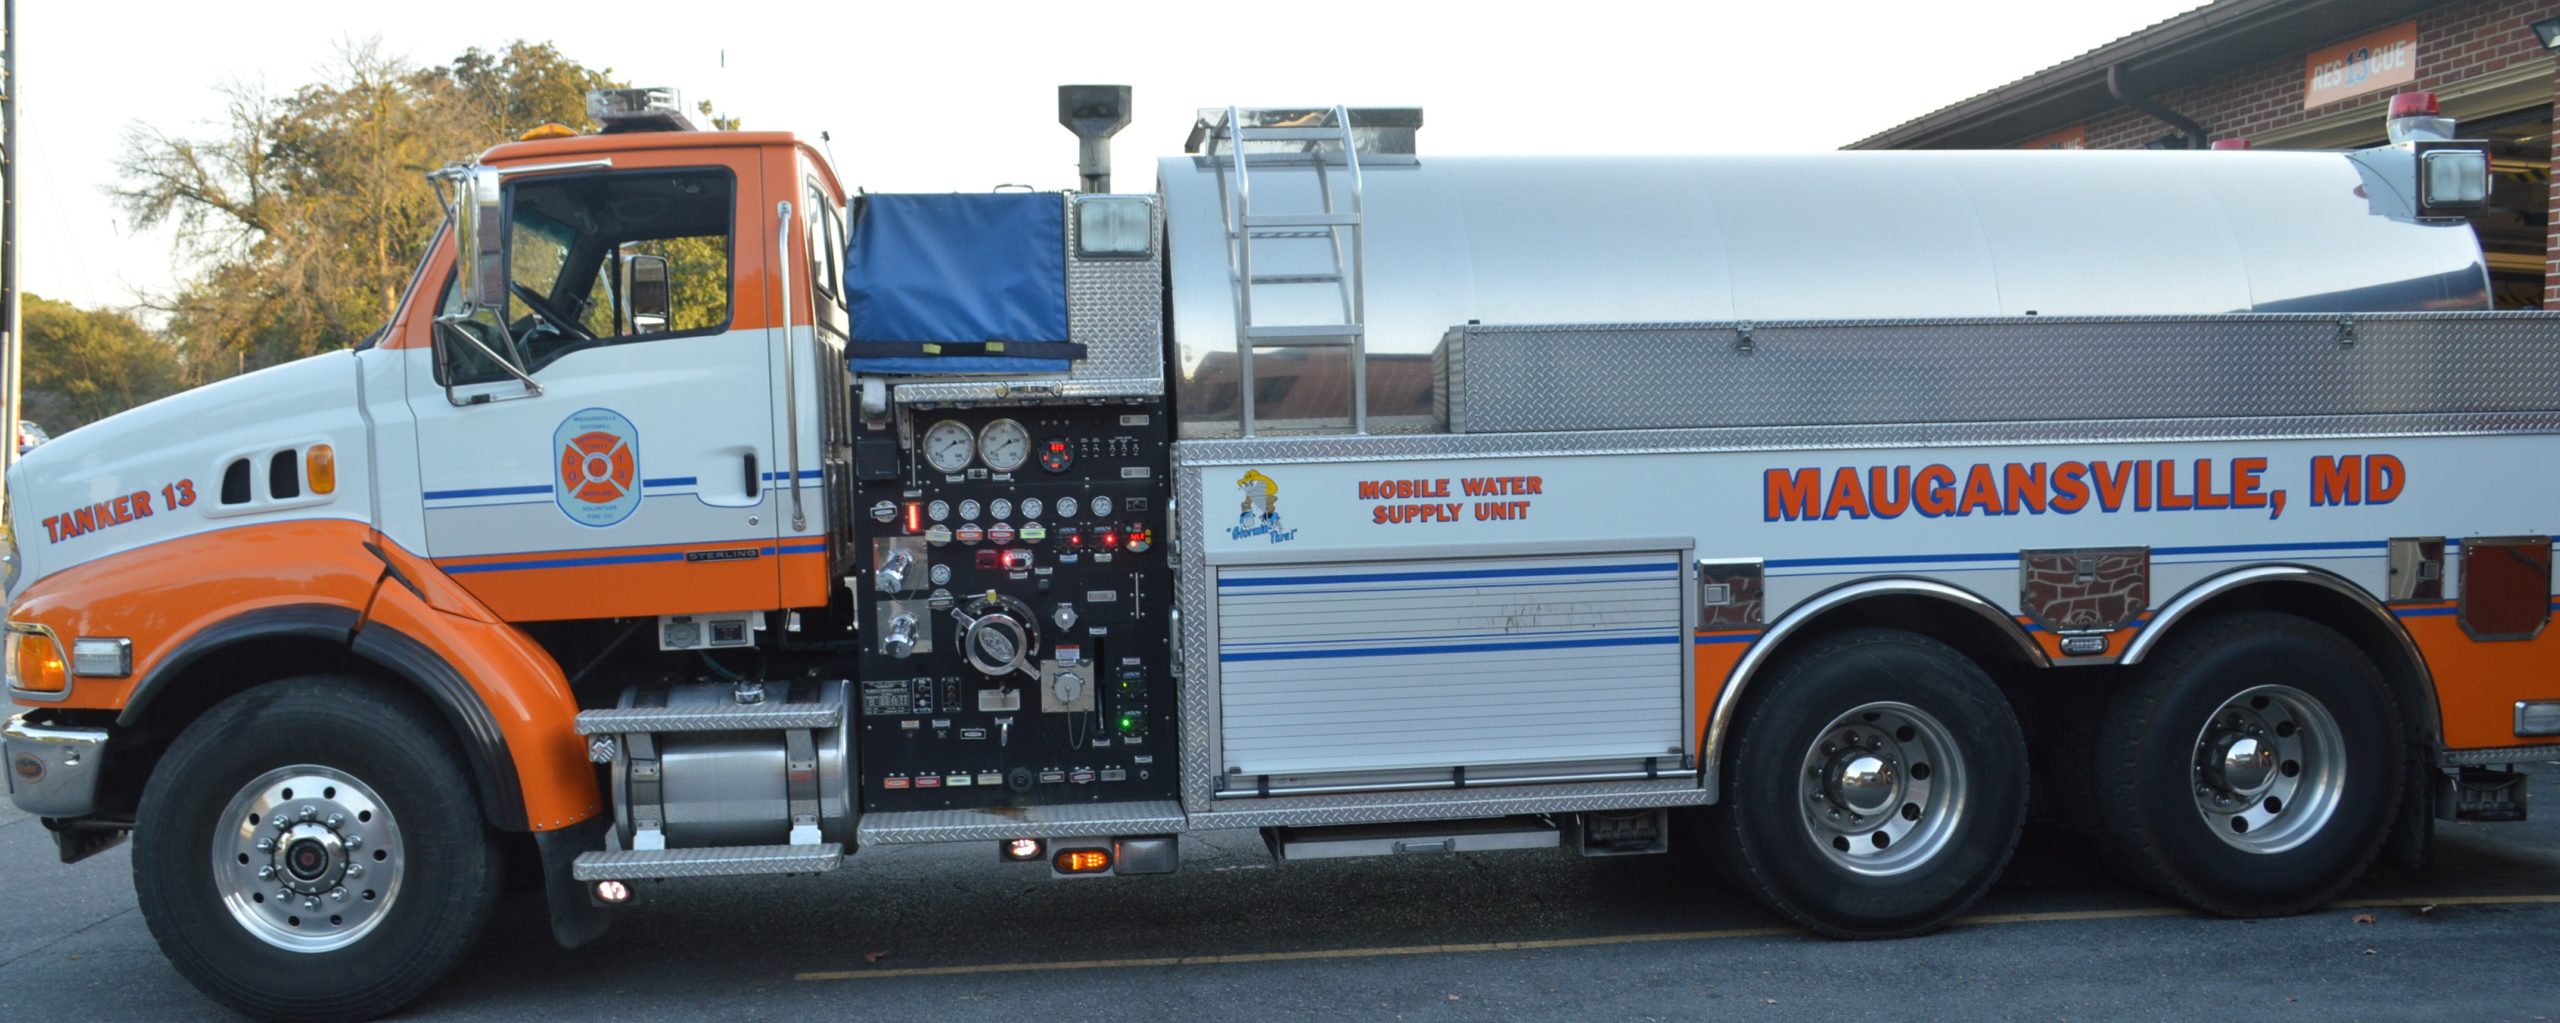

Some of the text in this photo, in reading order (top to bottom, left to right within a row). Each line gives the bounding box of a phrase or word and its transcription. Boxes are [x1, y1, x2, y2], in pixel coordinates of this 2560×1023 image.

[2313, 40, 2406, 92] RES 13 CUE
[1358, 476, 1543, 500] MOBILE WATER
[1764, 454, 2406, 522] MAUGANSVILLE, MD
[42, 478, 197, 544] TANKER 13
[1373, 501, 1531, 524] SUPPLY UNIT
[689, 549, 757, 561] STERLING
